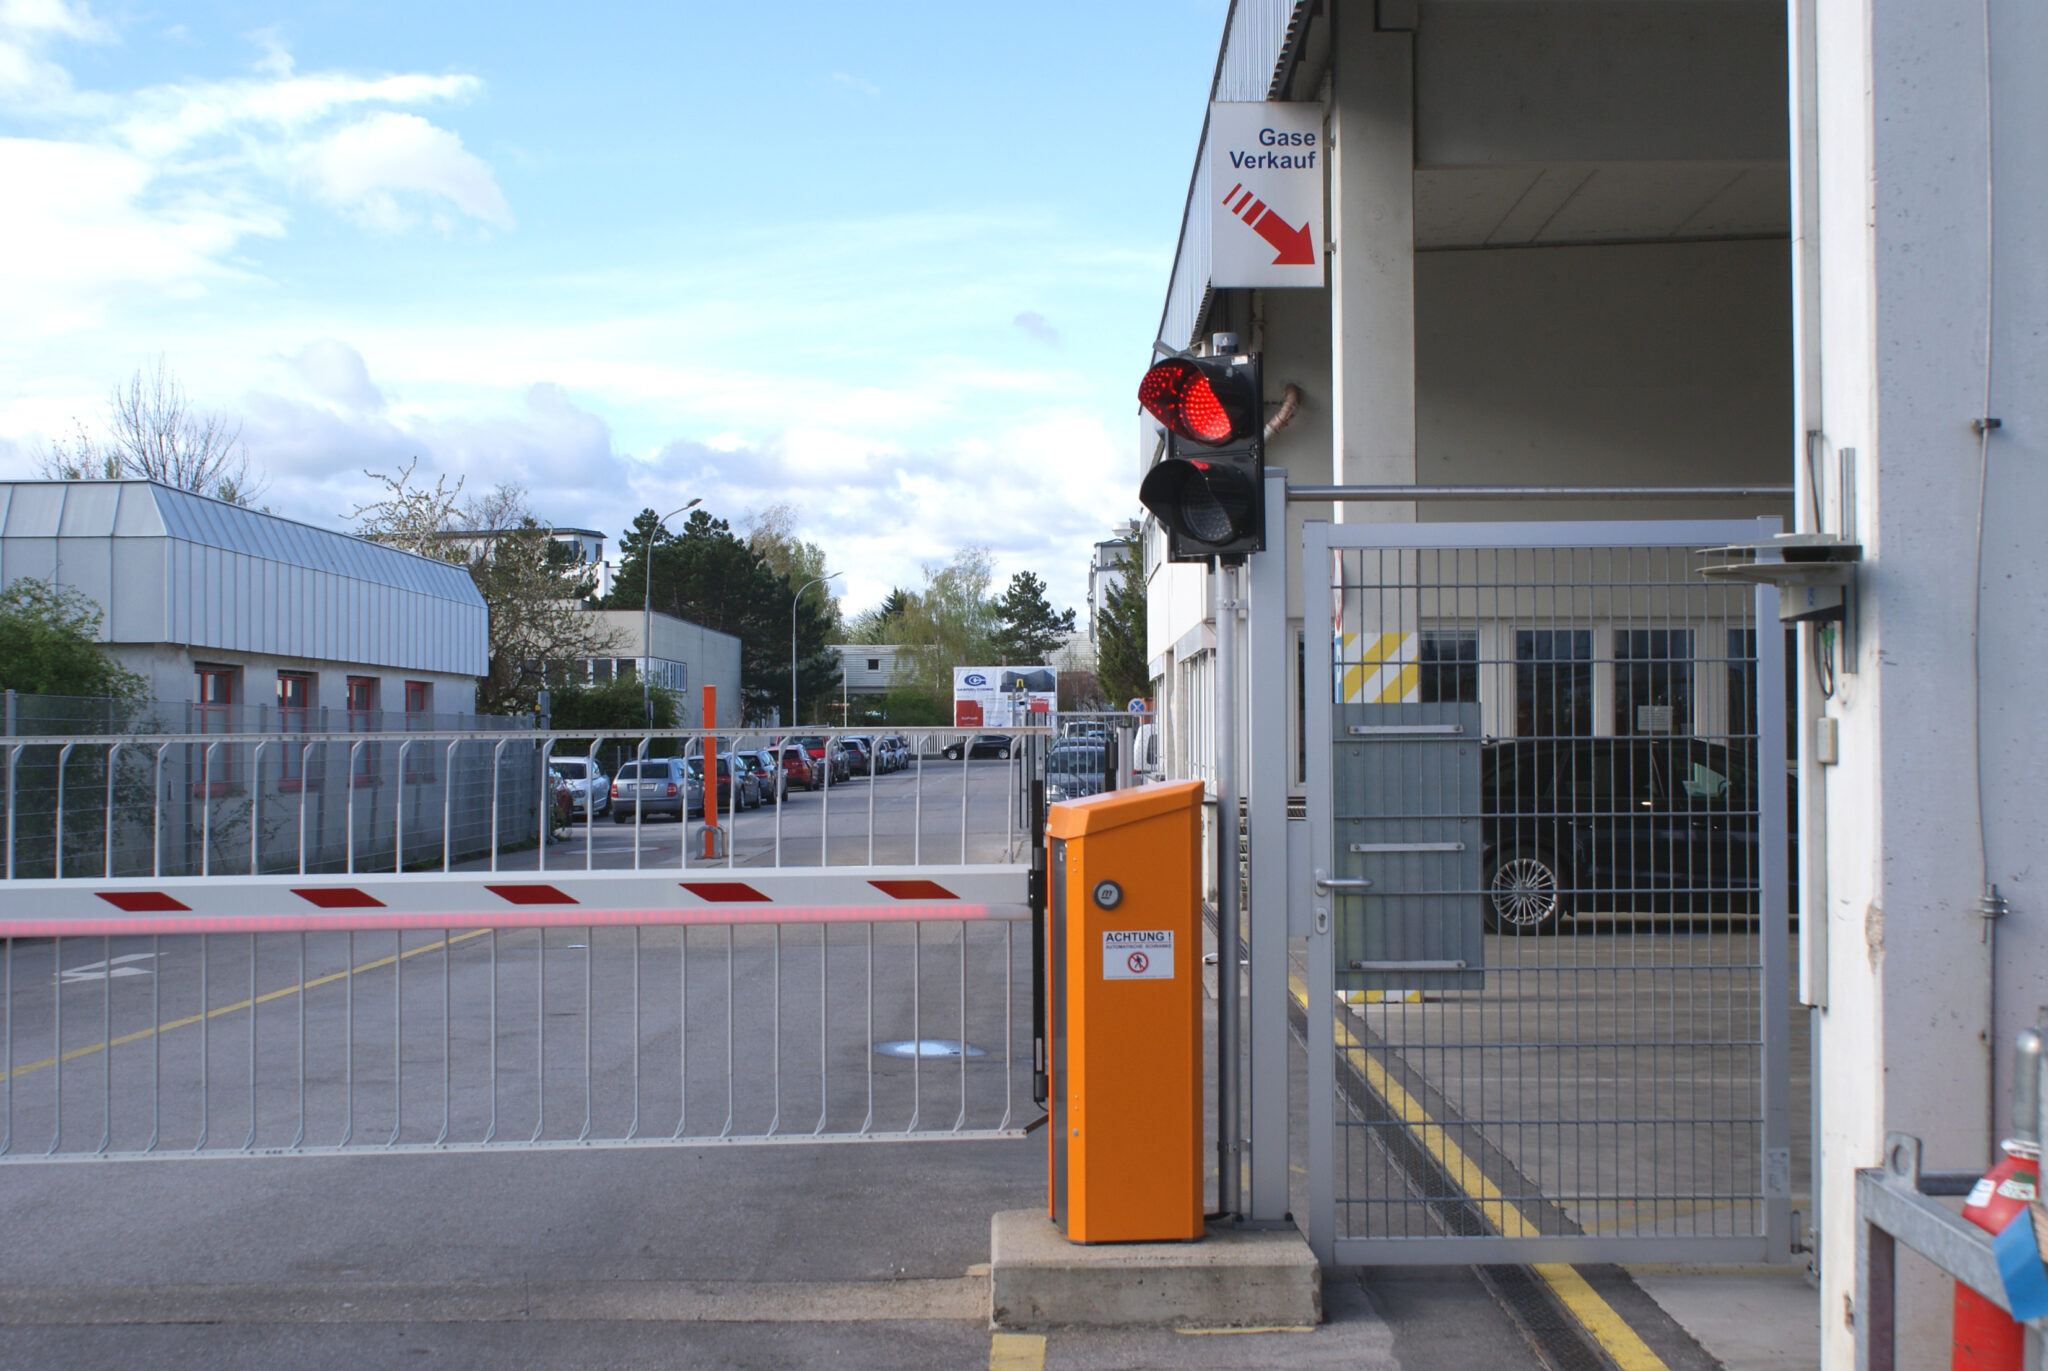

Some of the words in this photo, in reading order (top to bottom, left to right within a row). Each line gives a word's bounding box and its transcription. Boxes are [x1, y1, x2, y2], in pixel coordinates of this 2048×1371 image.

[1259, 128, 1316, 146] Gase
[1229, 151, 1316, 169] Verkauf
[1106, 931, 1165, 942] ACHTUNG
